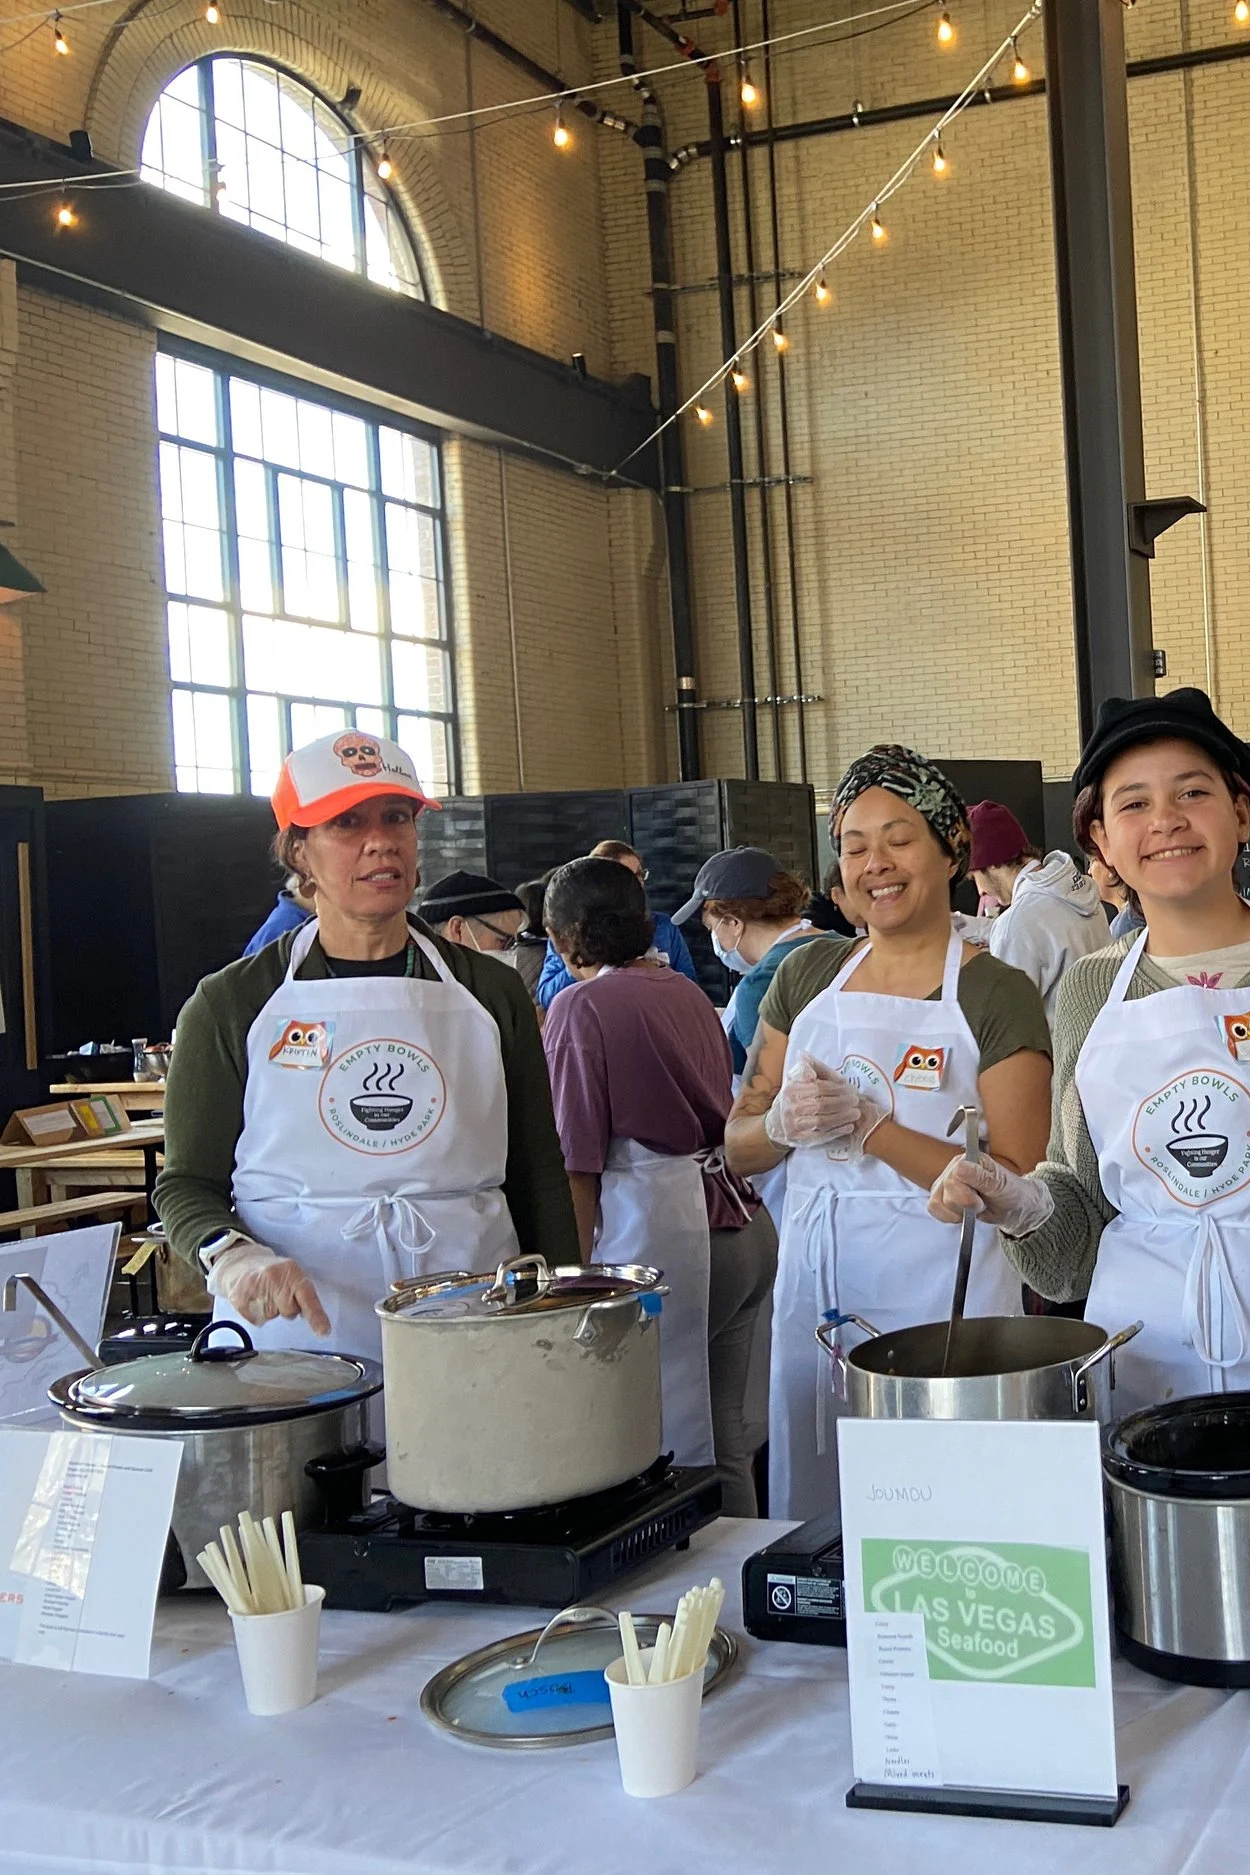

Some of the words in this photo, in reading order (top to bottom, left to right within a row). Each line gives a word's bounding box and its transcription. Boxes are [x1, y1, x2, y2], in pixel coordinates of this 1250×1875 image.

[339, 1044, 381, 1072] EMPTY
[388, 1044, 430, 1073] BOWLS
[1145, 1080, 1186, 1115] EMPTY
[1192, 1075, 1239, 1102] BOWLS
[329, 1109, 379, 1148] ROSLINDALE
[390, 1131, 418, 1146] HYDE
[417, 1107, 435, 1131] PARK
[1150, 1156, 1200, 1198] ROSLINDALE
[1212, 1174, 1239, 1194] HYDE
[866, 1484, 932, 1502] JOUMOU
[896, 1553, 1042, 1588] WELCOME
[894, 1591, 950, 1622] LAS
[957, 1600, 1056, 1641] VEGAS
[937, 1626, 1019, 1658] Seafood
